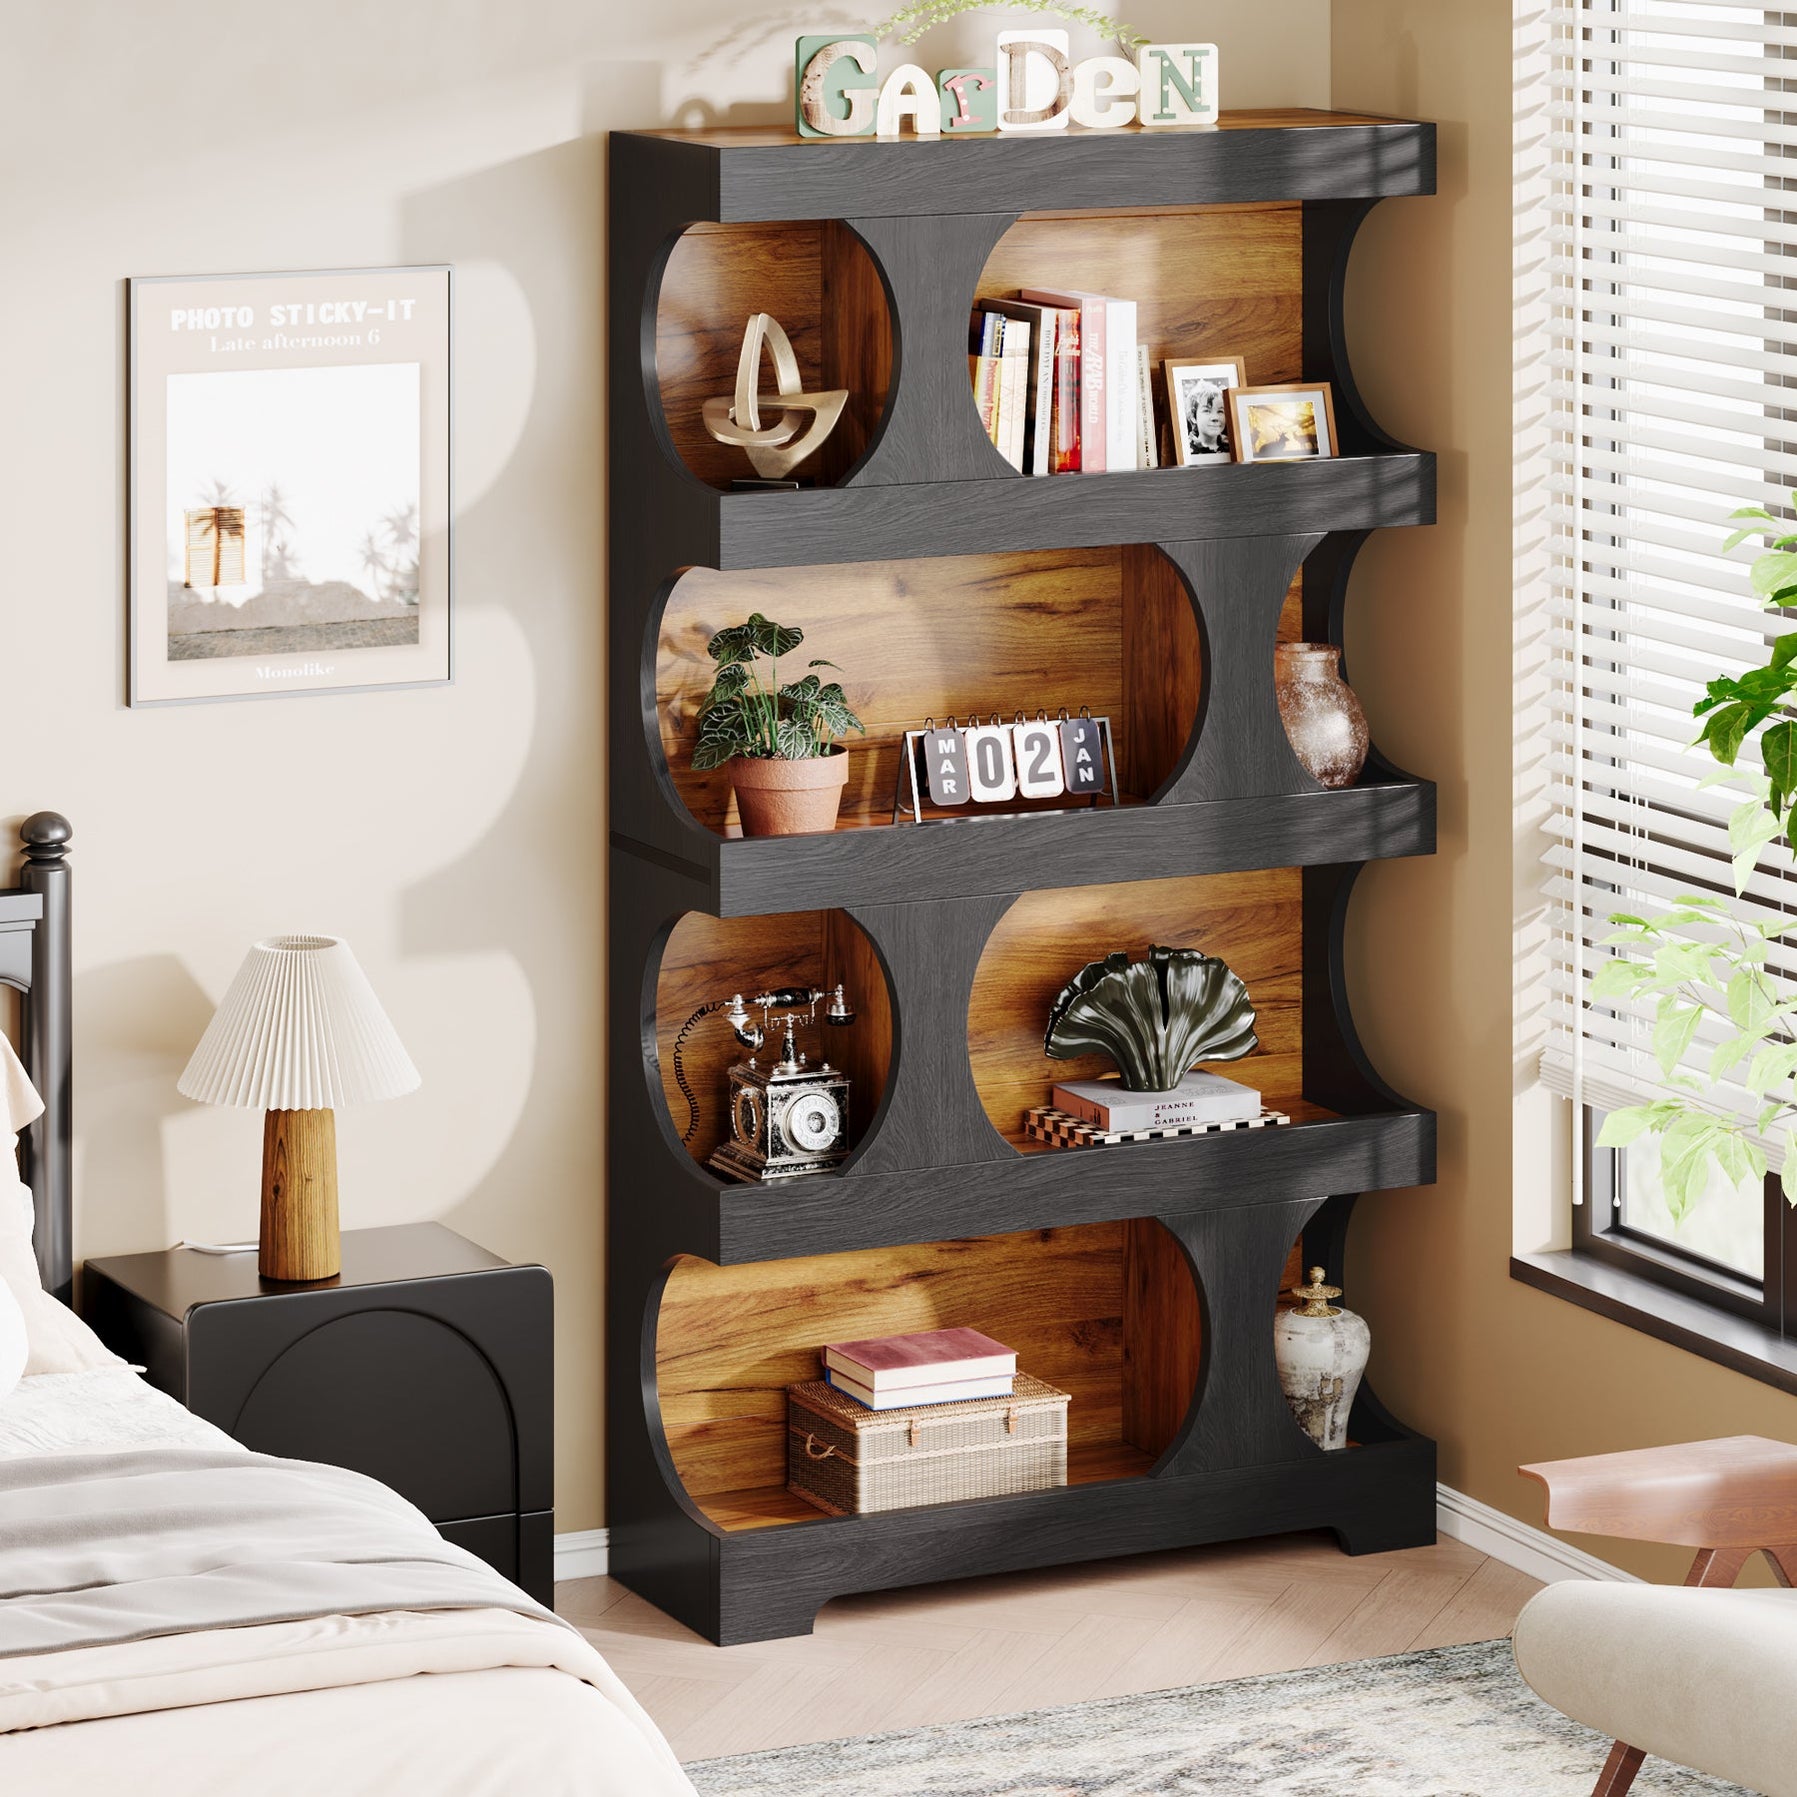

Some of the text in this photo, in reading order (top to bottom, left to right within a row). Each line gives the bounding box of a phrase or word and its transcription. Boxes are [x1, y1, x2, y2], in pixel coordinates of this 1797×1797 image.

[170, 299, 416, 331] PHOTO STICKY-IT
[210, 328, 381, 353] Late afternoon 6
[1042, 349, 1050, 384] DYLAN
[1085, 333, 1104, 424] THE ARAB WORLD
[255, 662, 336, 680] Monolike
[938, 738, 957, 794] MAR
[1073, 728, 1095, 783] JAN
[1154, 1102, 1194, 1111] JEANNE
[1154, 1115, 1198, 1125] GABRIEL
